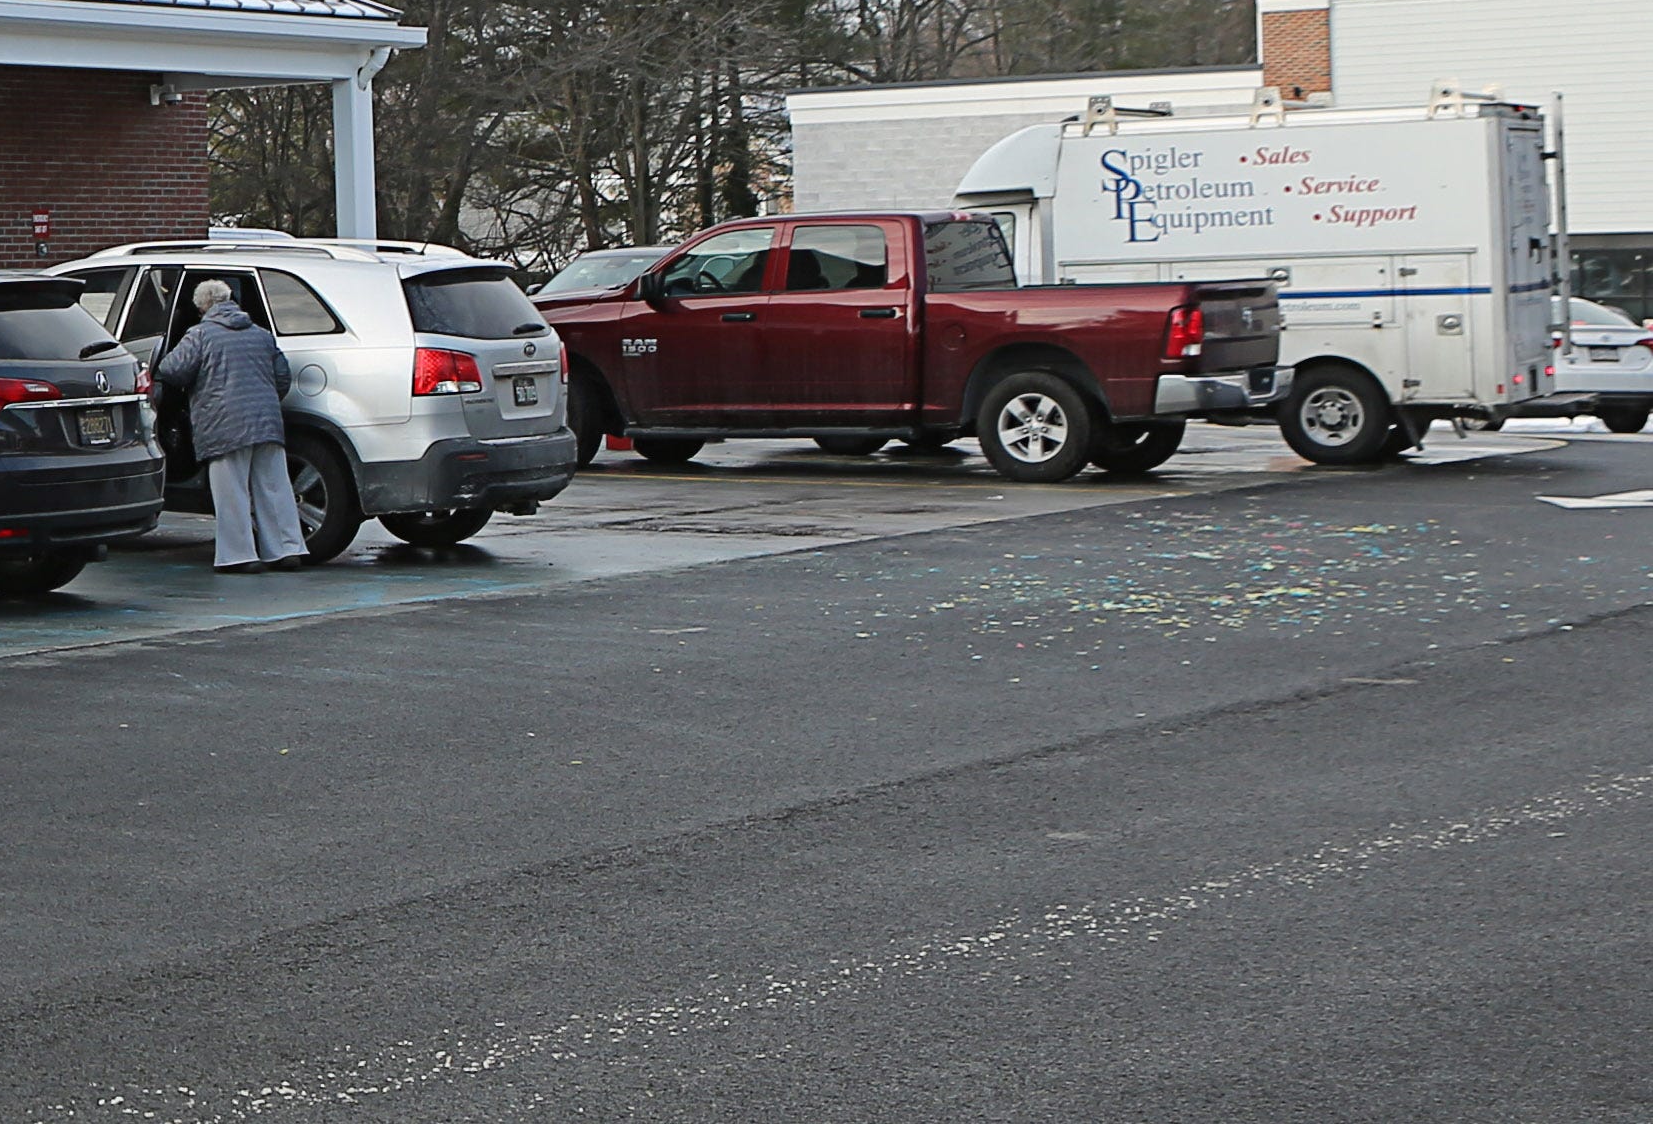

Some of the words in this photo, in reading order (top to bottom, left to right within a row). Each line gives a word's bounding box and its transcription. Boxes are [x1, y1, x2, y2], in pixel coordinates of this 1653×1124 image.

[1100, 147, 1204, 193] Spigler
[1252, 146, 1312, 166] Sales
[1111, 177, 1255, 220] Petroleum
[1297, 175, 1381, 196] Service
[1123, 200, 1275, 244] Equipment
[1327, 204, 1418, 228] Support
